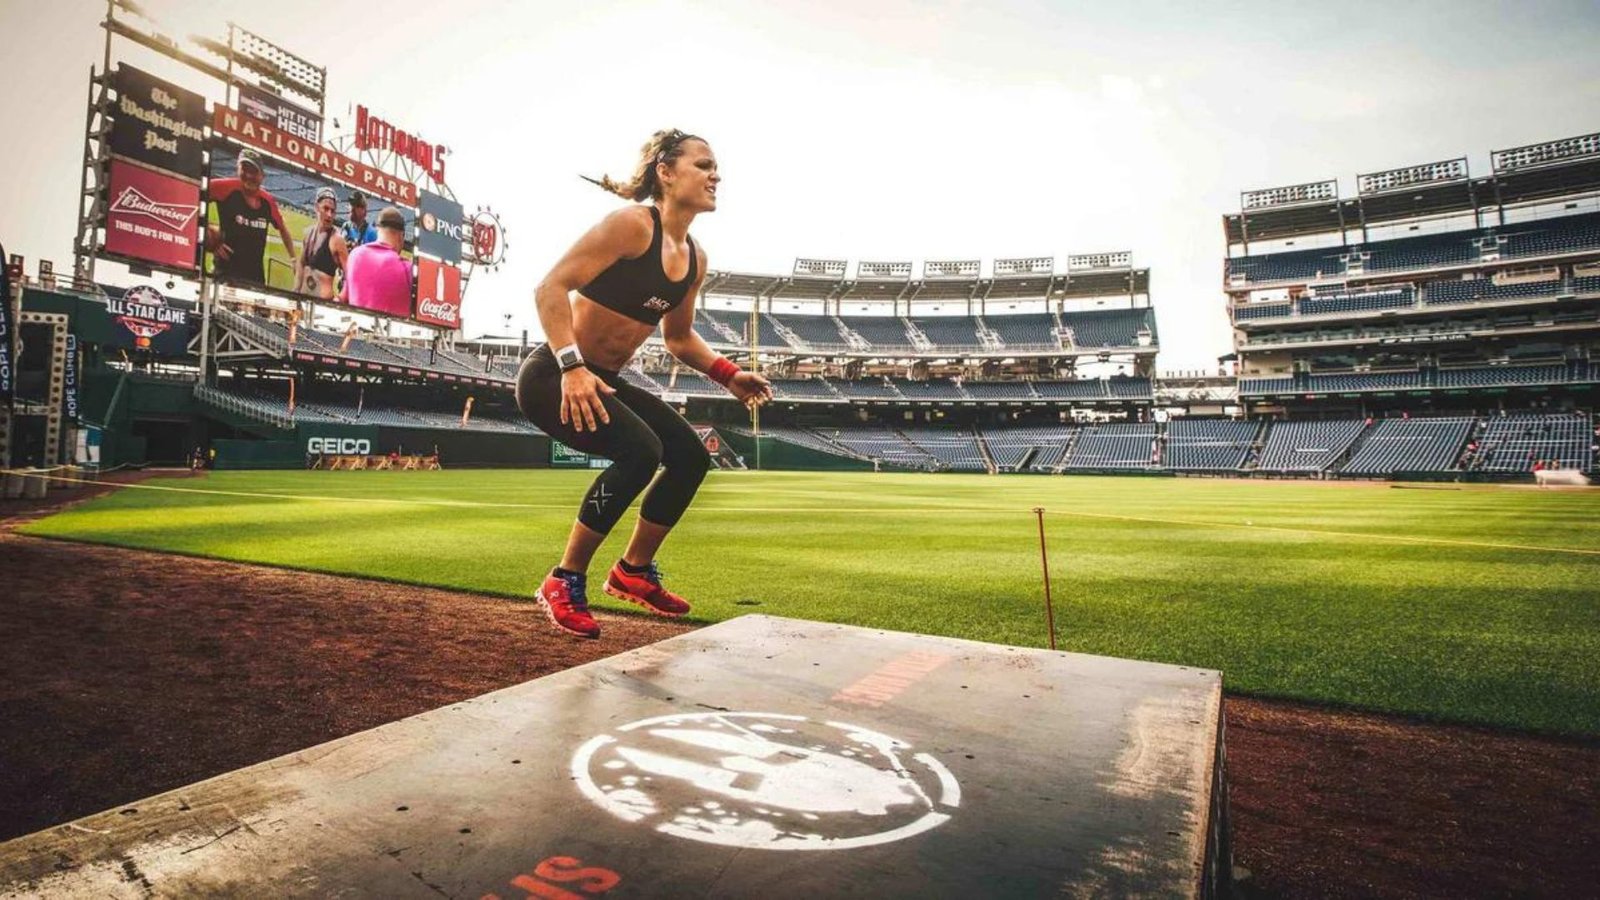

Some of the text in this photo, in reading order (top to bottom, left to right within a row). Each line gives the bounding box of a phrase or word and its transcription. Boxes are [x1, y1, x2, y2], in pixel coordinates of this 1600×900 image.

[151, 87, 177, 110] The
[120, 94, 202, 141] Washington
[278, 106, 296, 120] HIT
[297, 114, 307, 125] IT
[144, 130, 177, 154] Post
[277, 116, 316, 143] HERE
[224, 112, 411, 200] NATIONALS PARK
[355, 104, 446, 185] NATIONALS
[119, 191, 190, 221] Budweiser
[115, 220, 134, 233] THIS
[134, 225, 158, 239] BUD'S
[158, 231, 173, 242] FOR
[436, 218, 462, 240] PNC
[105, 298, 124, 315] ALL
[126, 302, 156, 320] STAR
[157, 307, 186, 325] GAME
[65, 351, 77, 417] ROPE CLIMB
[307, 437, 371, 456] GEICO
